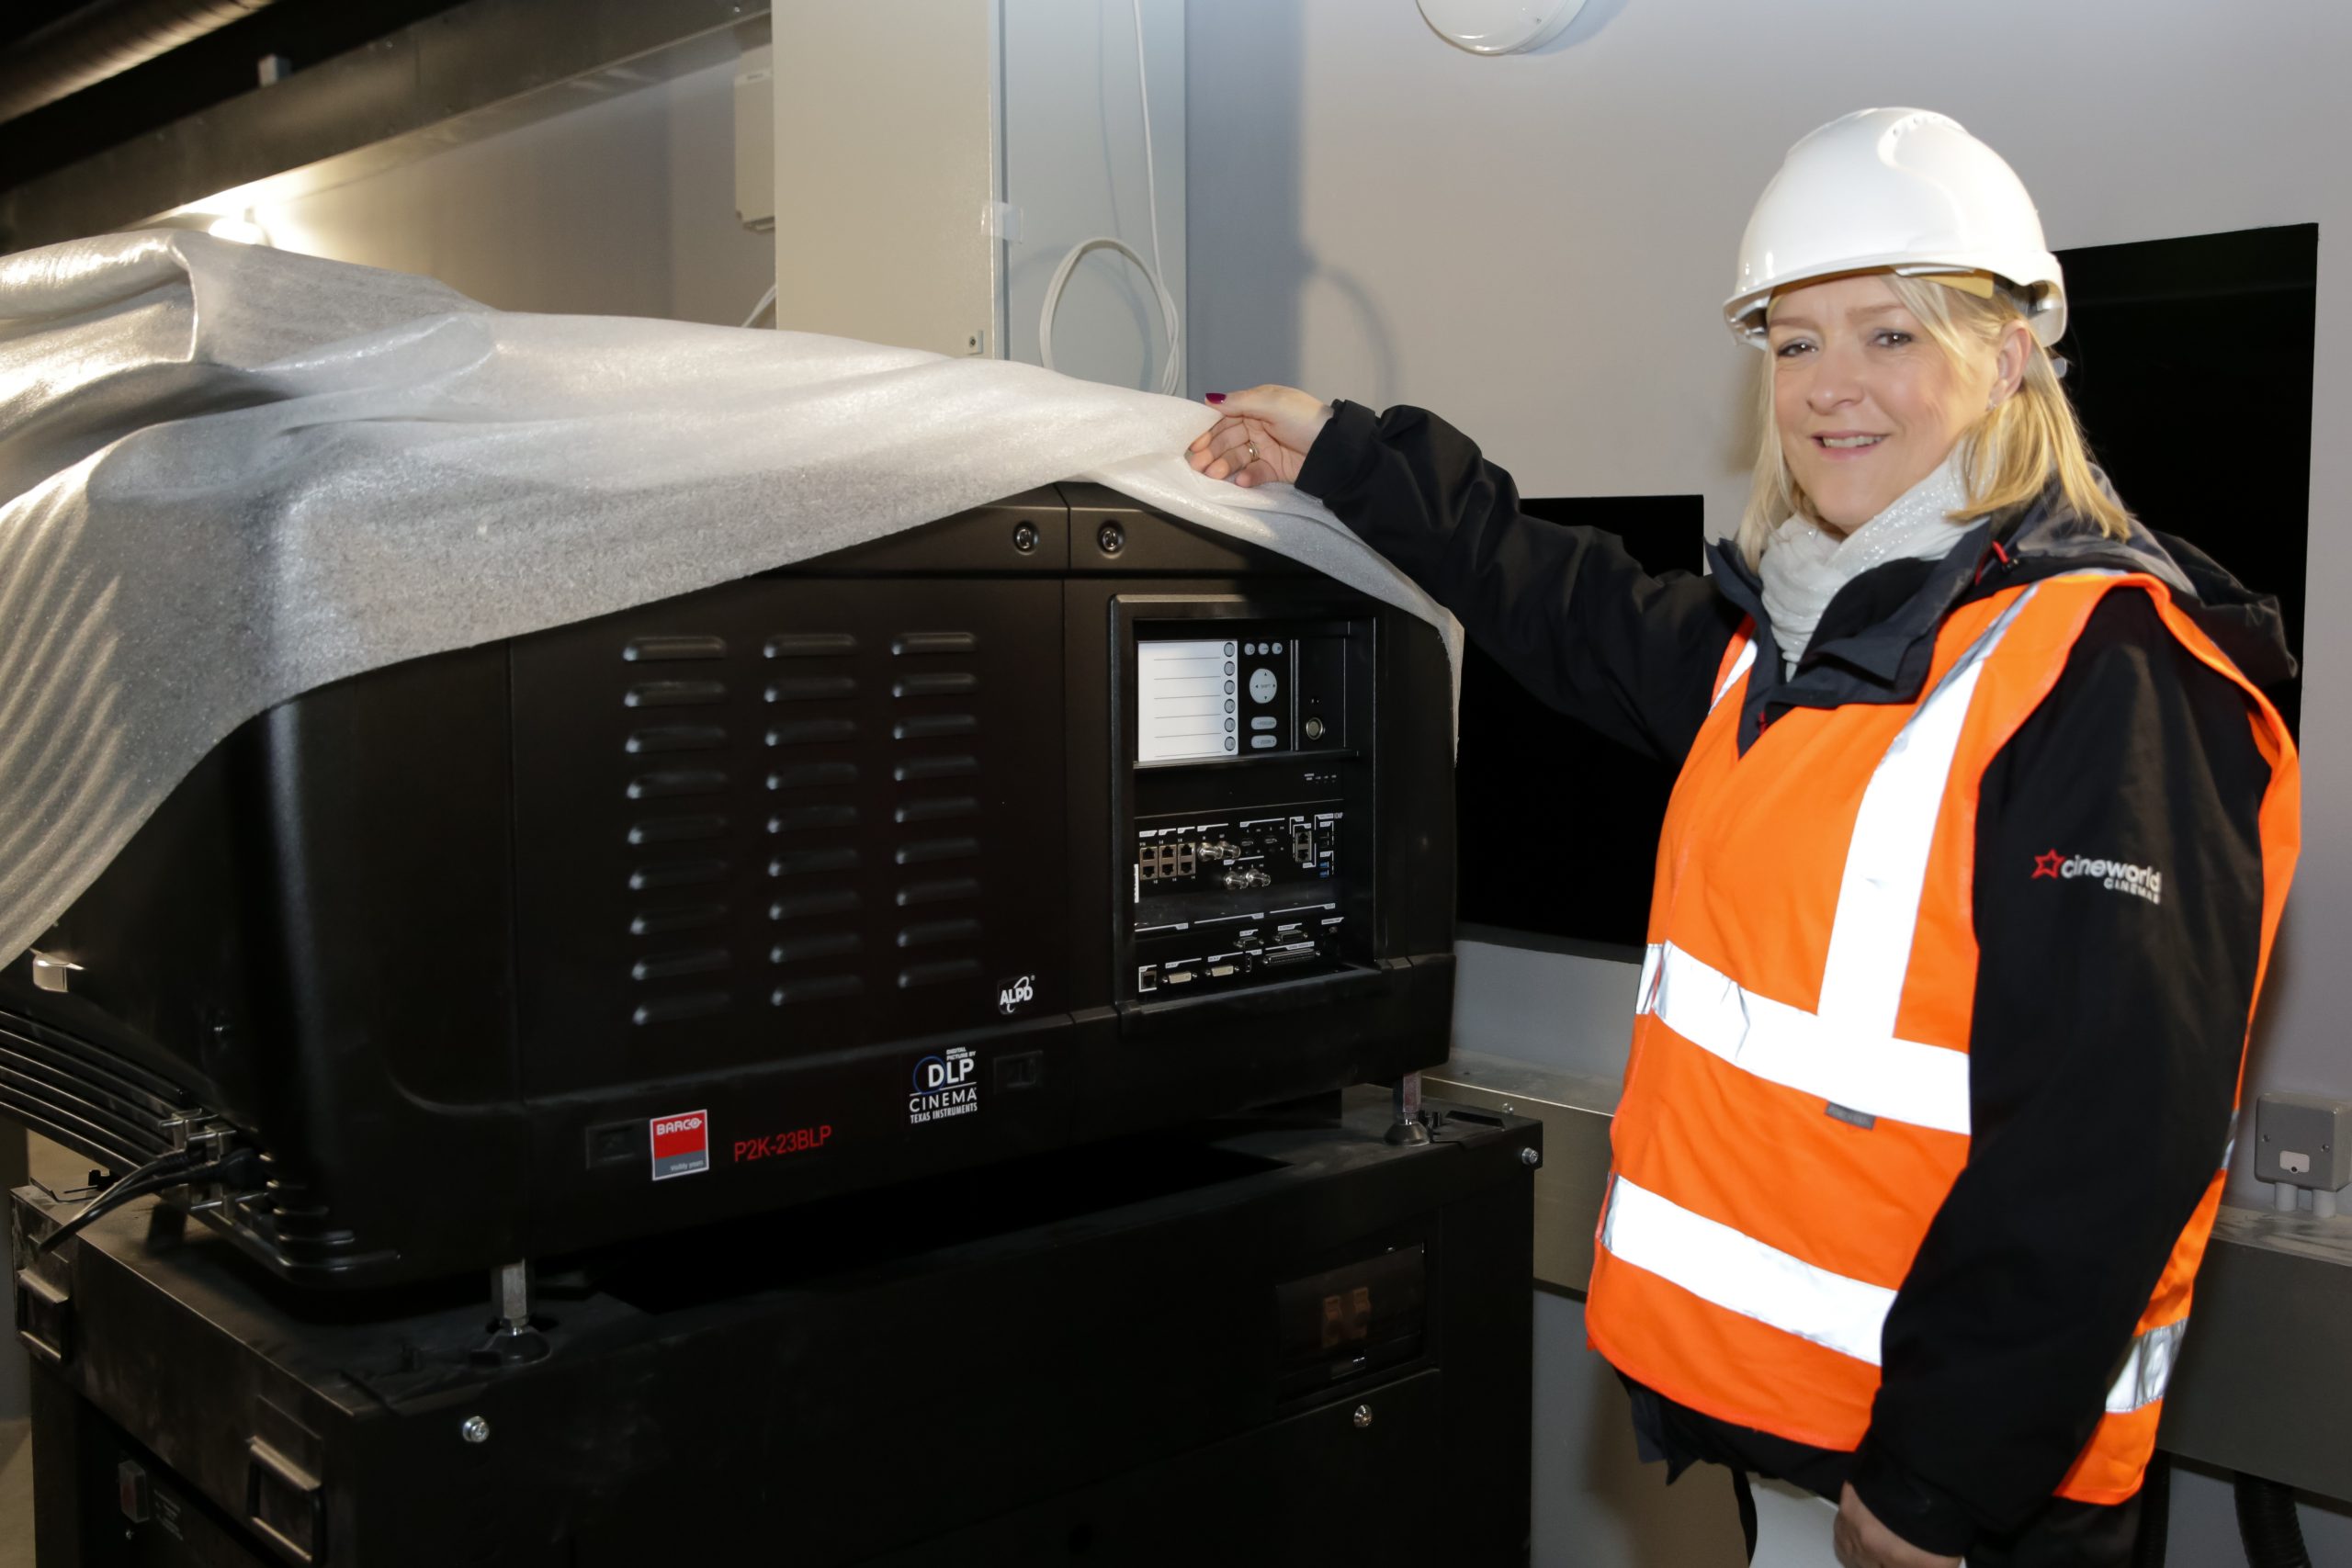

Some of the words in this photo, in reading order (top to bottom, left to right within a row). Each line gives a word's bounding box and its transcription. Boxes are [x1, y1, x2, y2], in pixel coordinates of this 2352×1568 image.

[2061, 854, 2162, 893] cineworld
[1000, 985, 1034, 1006] ALPD
[928, 1058, 975, 1088] DLP
[910, 1088, 978, 1112] CINEMA
[910, 1111, 931, 1124] TEXAS
[933, 1102, 978, 1120] INSTRUMENTS
[656, 1117, 702, 1135] BARCO
[734, 1125, 832, 1162] P2K-23BLP
